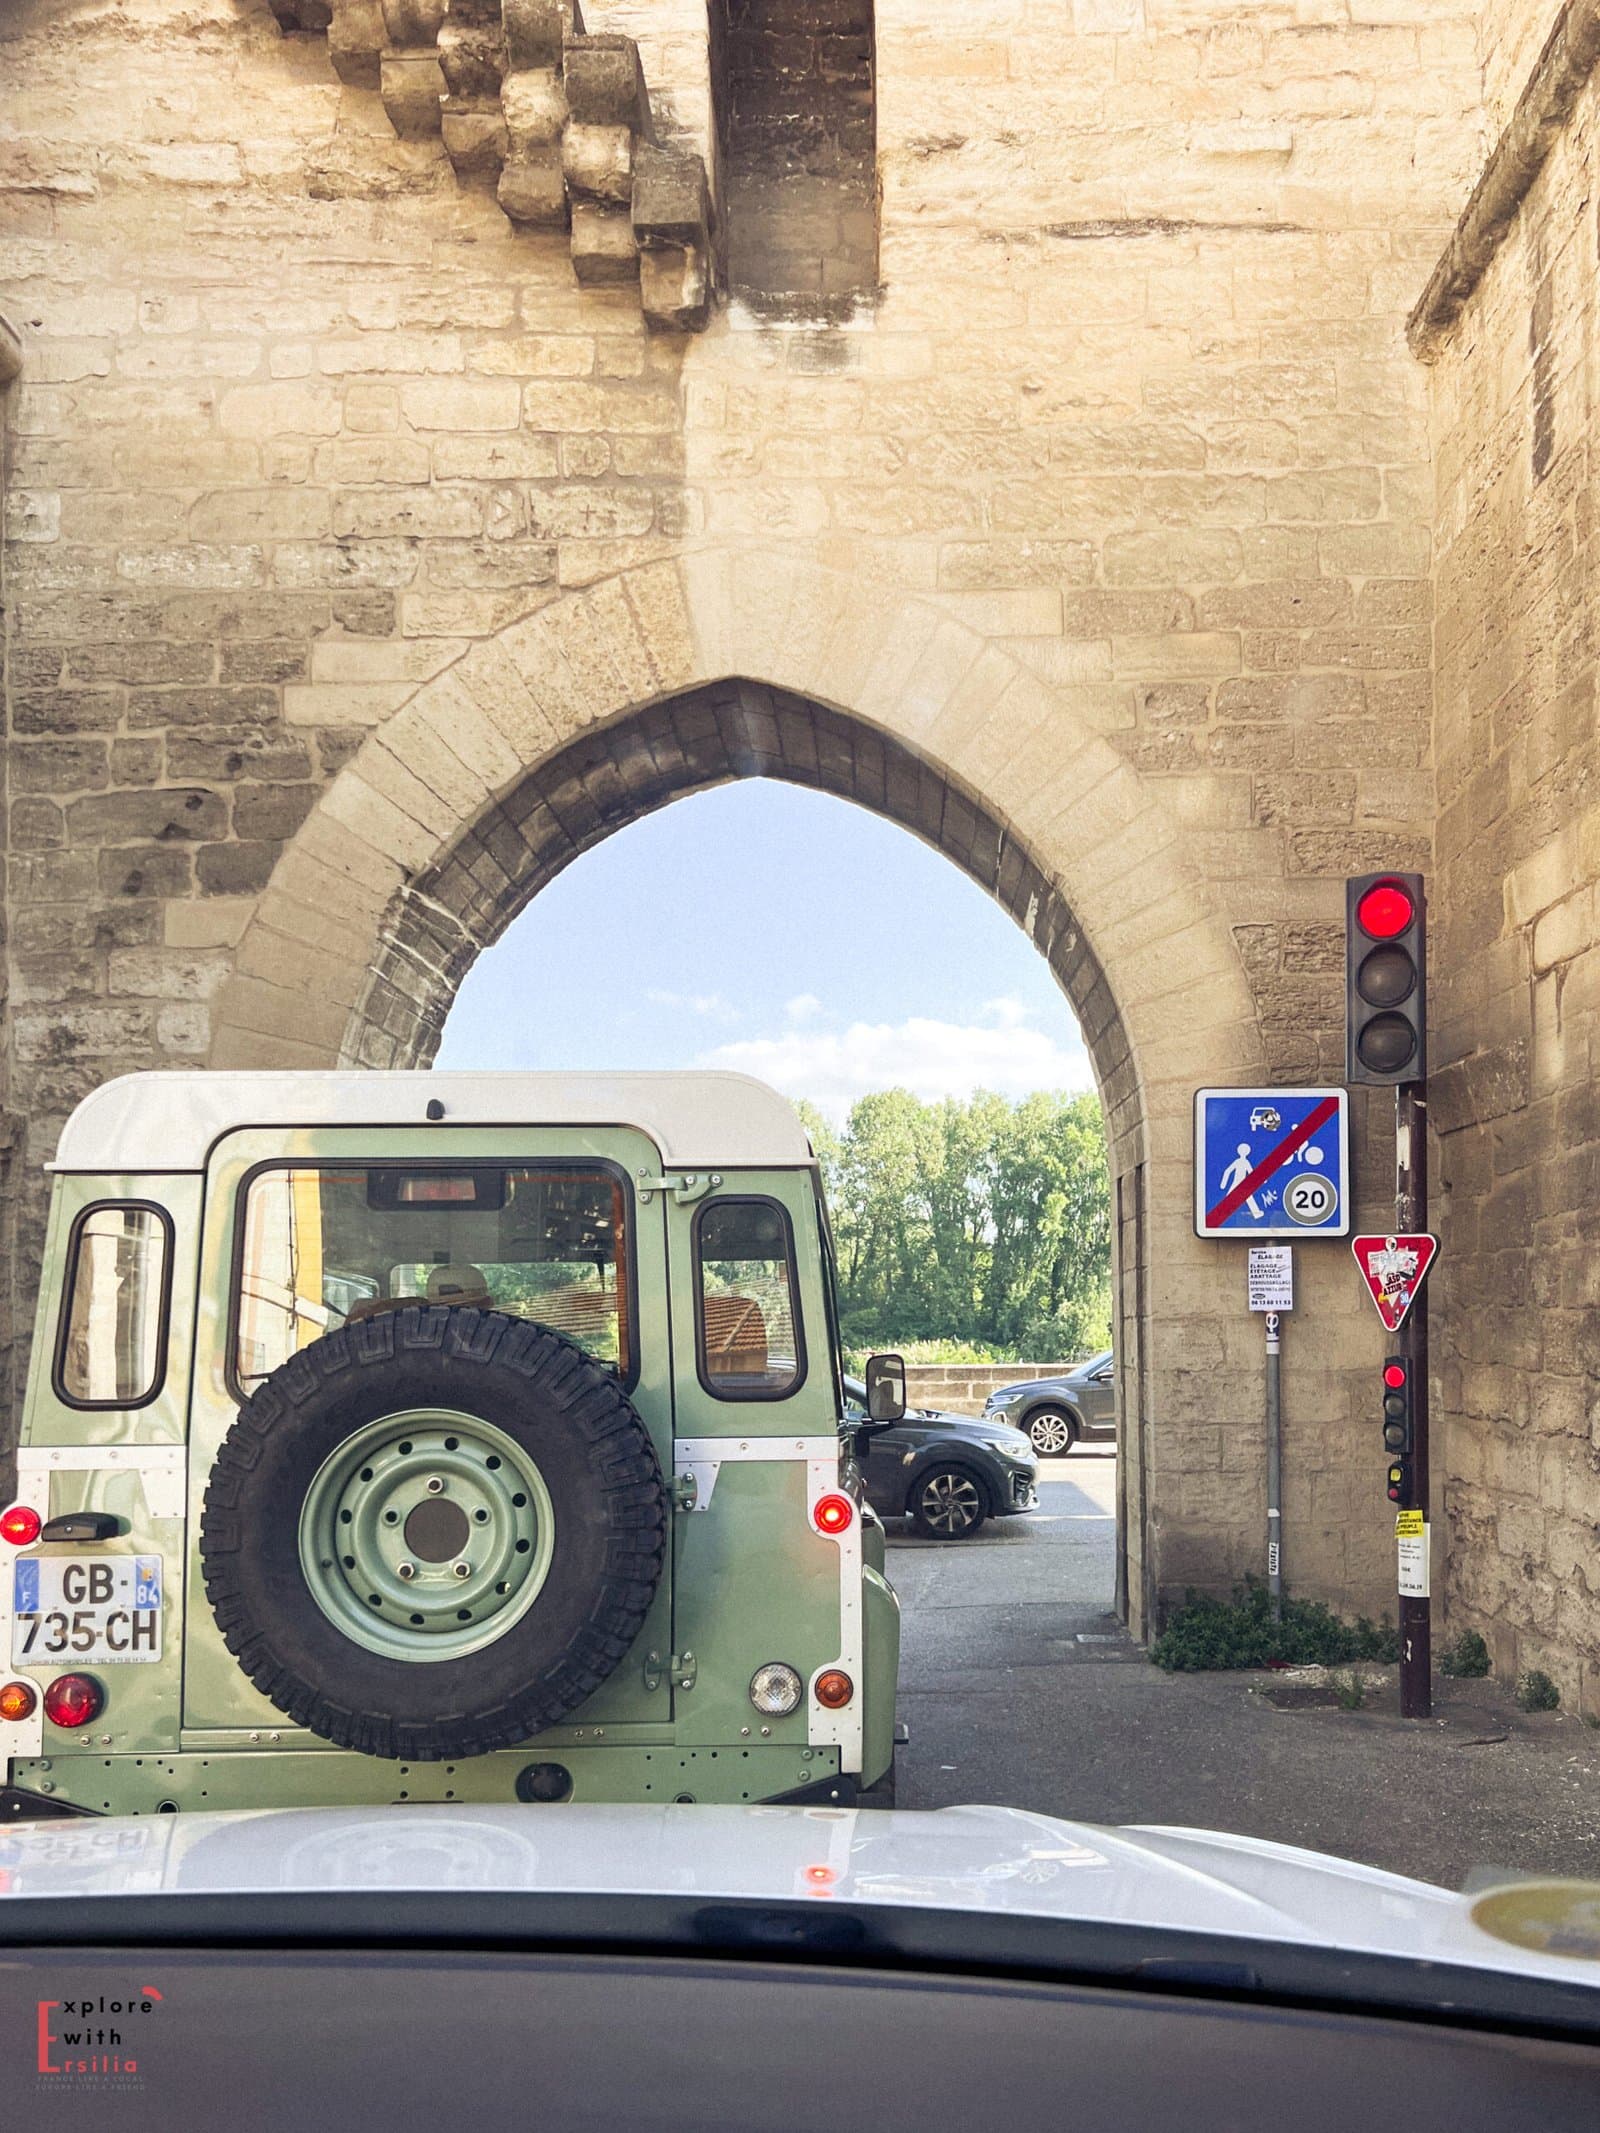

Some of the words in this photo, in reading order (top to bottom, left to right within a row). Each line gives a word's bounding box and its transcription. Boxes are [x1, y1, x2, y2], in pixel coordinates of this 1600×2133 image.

[1295, 1190, 1325, 1209] 20
[22, 1591, 32, 1603] F
[137, 1582, 158, 1604] 84
[18, 1610, 157, 1654] 735-CH
